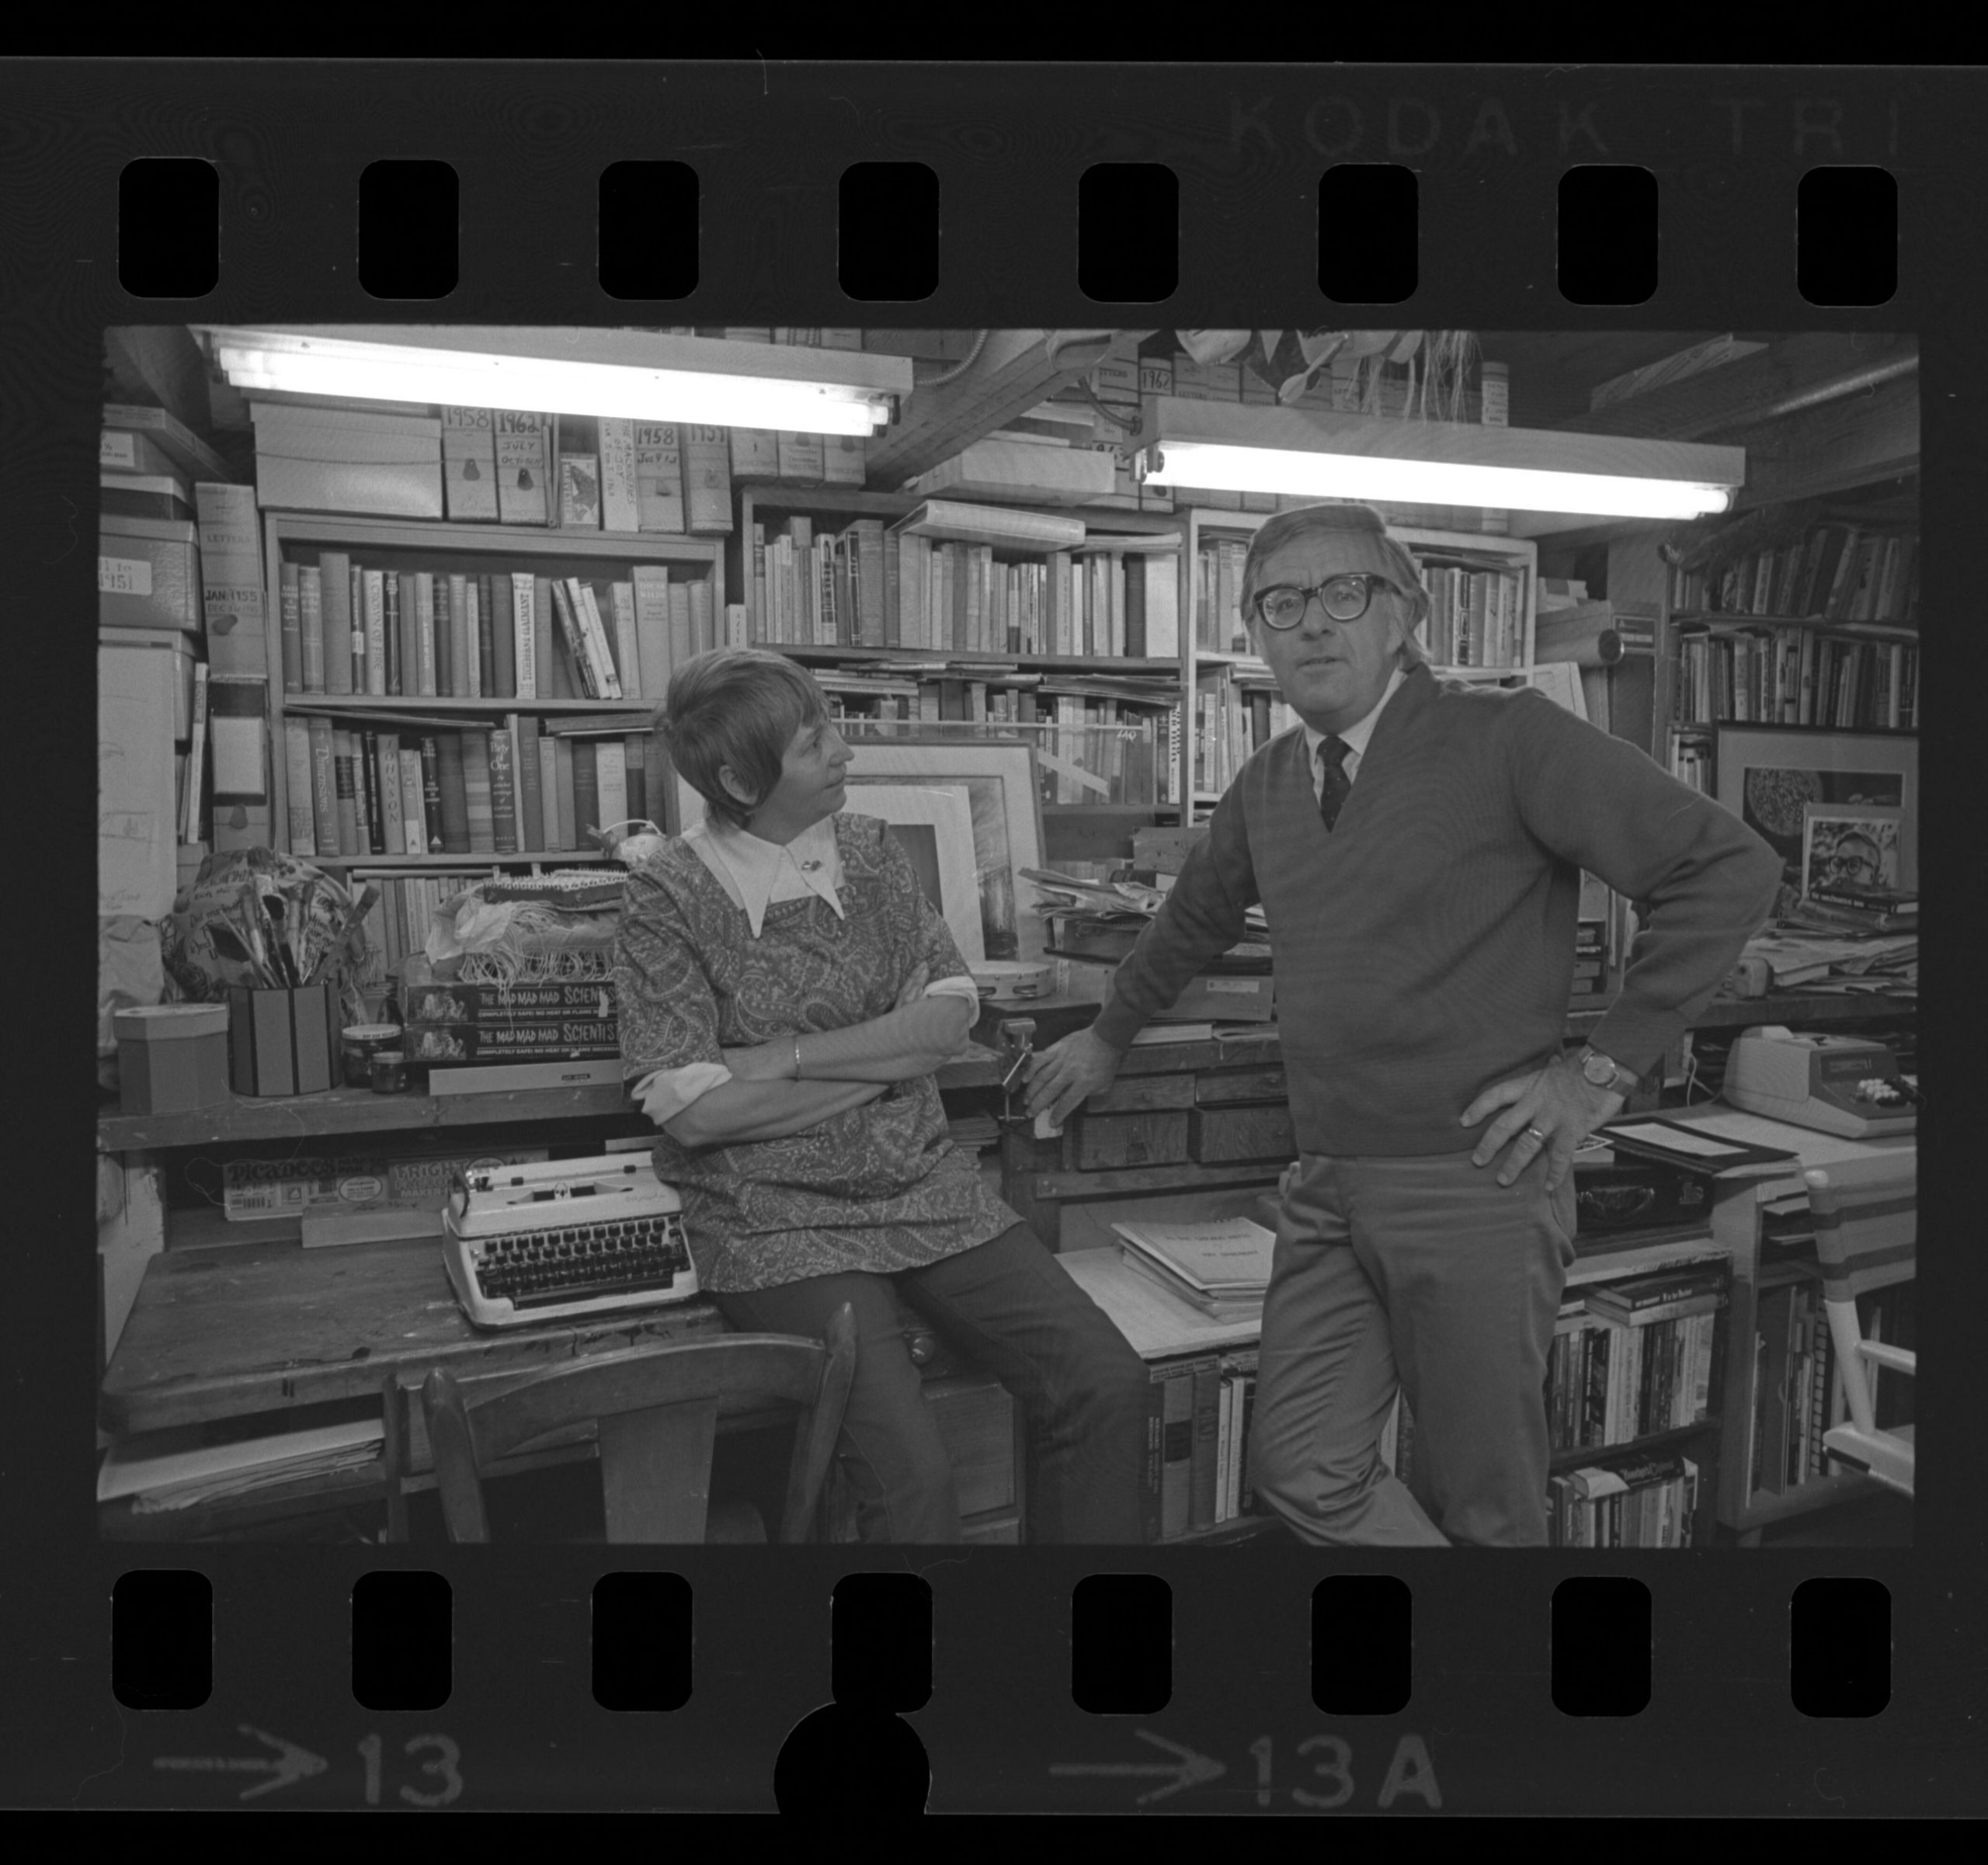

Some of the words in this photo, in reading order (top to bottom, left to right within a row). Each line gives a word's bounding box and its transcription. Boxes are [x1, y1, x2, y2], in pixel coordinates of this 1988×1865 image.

[1229, 96, 1610, 157] KODAK
[1708, 96, 1901, 156] TRI
[448, 408, 490, 428] 1958
[499, 413, 540, 434] 1962
[638, 428, 675, 445] 1958
[503, 441, 536, 450] JULY
[207, 534, 251, 544] LETTERS
[371, 584, 381, 627] CROWN
[372, 629, 382, 641] OF
[490, 741, 509, 754] Party
[490, 759, 510, 770] One
[315, 745, 332, 813] Dimensions
[481, 992, 495, 1006] THE
[498, 992, 516, 1006] MAD
[517, 991, 537, 1007] MAD
[539, 990, 561, 1004] MAD
[479, 1030, 494, 1043] THE
[496, 1030, 516, 1044] MAD
[516, 1029, 537, 1044] MAD
[538, 1028, 559, 1040] MAD
[356, 1734, 464, 1807] 13
[1248, 1732, 1443, 1810] 13A
